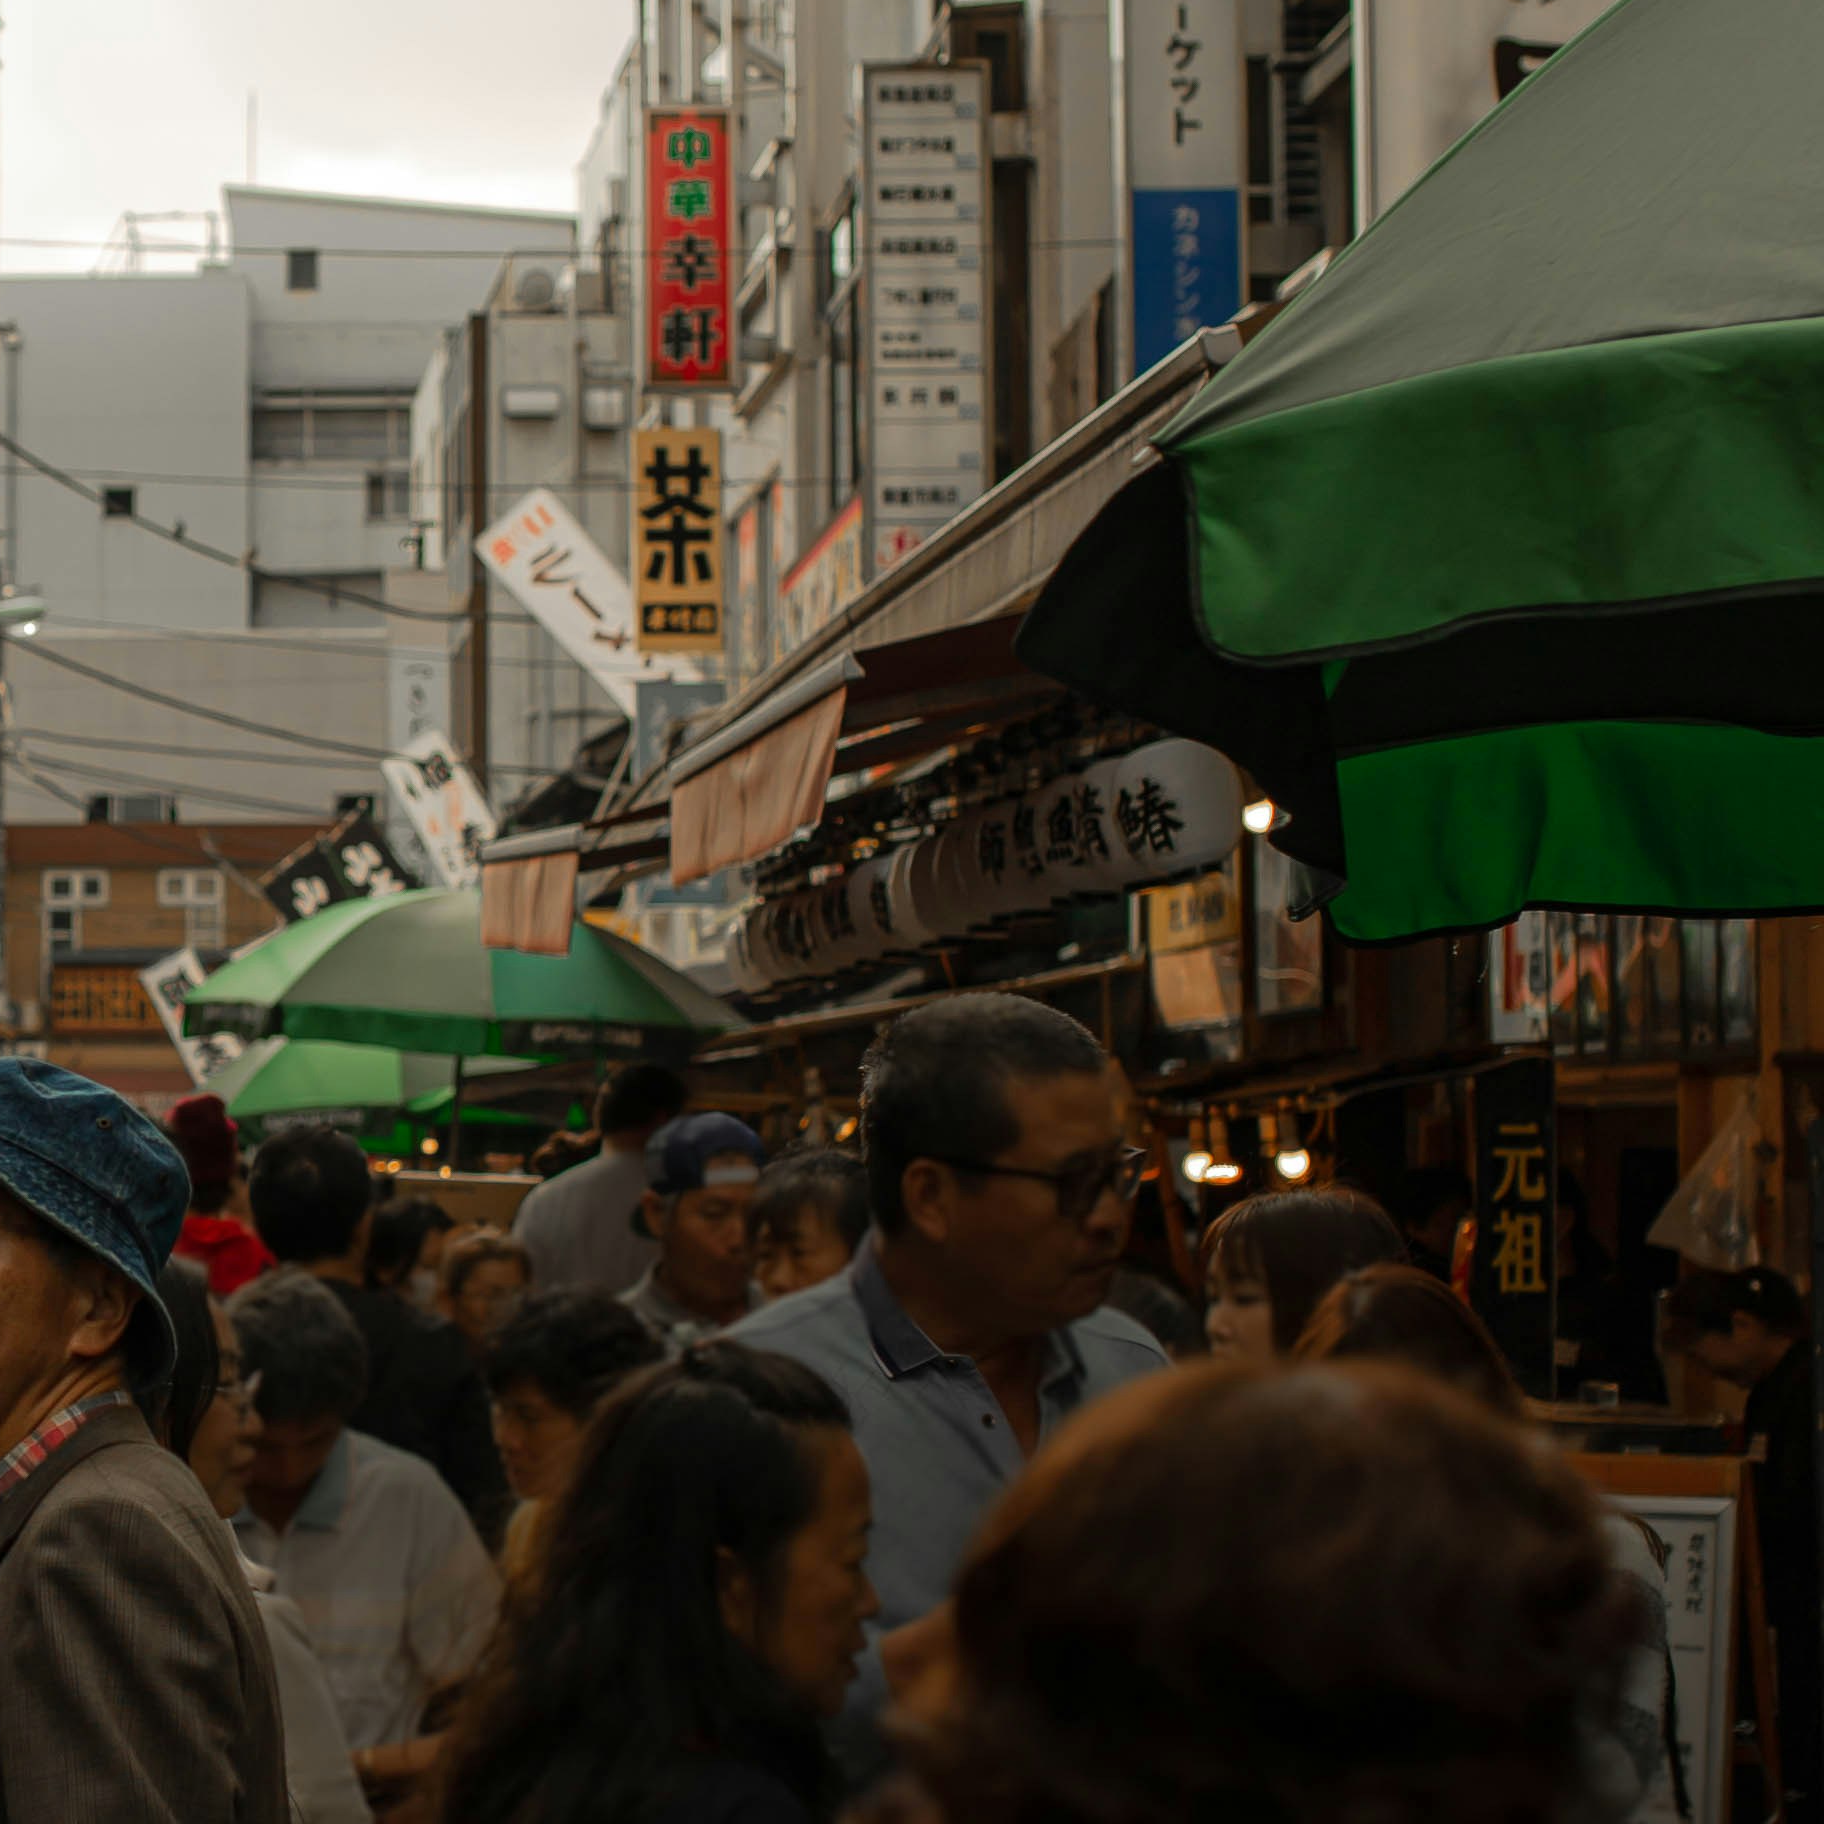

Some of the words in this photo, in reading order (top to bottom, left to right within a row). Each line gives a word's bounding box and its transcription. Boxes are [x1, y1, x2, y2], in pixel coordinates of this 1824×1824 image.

[660, 127, 719, 364] 中華幸軒
[642, 442, 715, 586] 茶
[1491, 1121, 1550, 1297] 元祖
